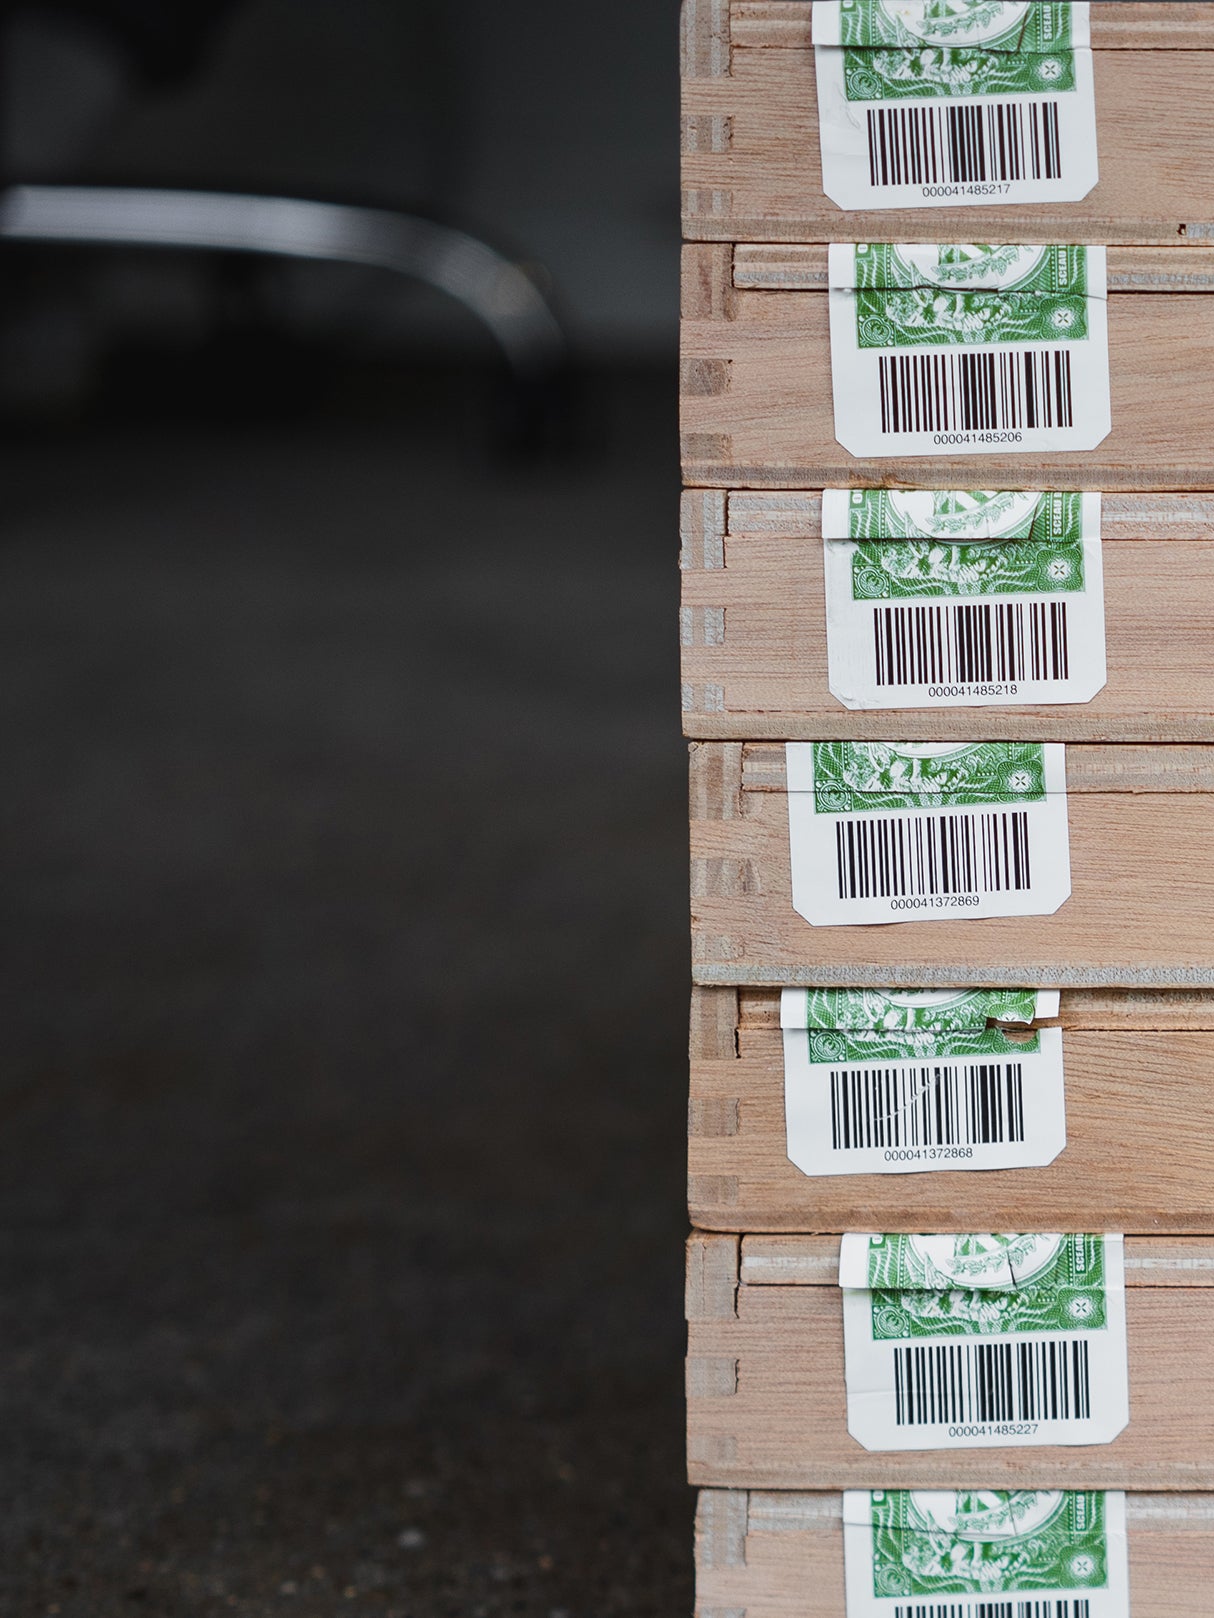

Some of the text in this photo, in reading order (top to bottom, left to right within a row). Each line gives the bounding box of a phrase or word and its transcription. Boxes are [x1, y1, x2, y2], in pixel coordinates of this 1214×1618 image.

[1043, 5, 1052, 40] SCEAU
[922, 184, 1011, 198] 000041485217
[1058, 250, 1067, 286] SCEAU
[933, 432, 1023, 446] 000041485206
[1053, 499, 1062, 535] SCEAU
[928, 684, 1018, 698] 000041485218
[890, 895, 980, 910] 000041372869
[884, 1148, 974, 1162] 000041372868
[1076, 1237, 1085, 1272] SCEAU
[948, 1424, 1039, 1438] 000041485227
[1076, 1495, 1085, 1530] SCEAU
